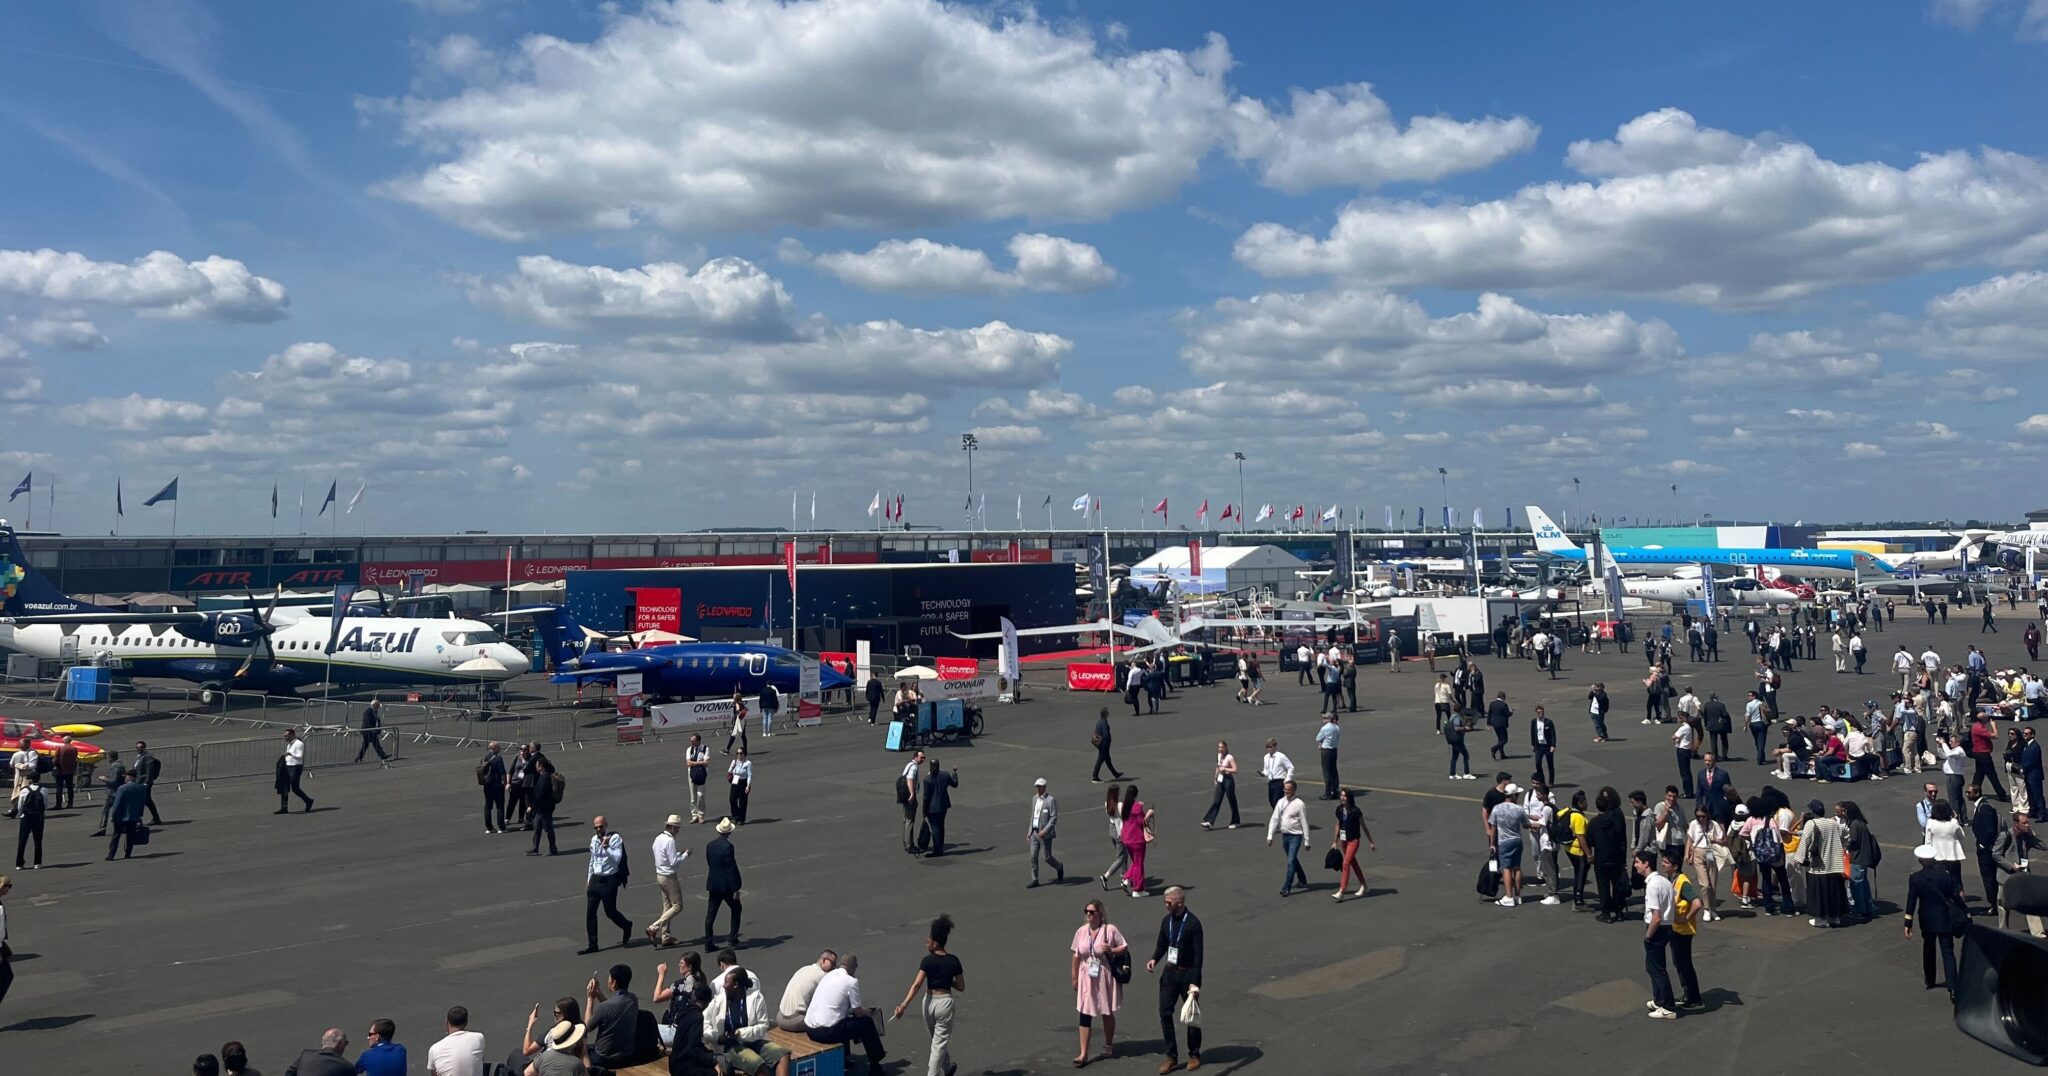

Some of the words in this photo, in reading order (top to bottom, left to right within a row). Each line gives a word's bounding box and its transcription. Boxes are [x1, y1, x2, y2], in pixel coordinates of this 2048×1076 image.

[186, 572, 253, 585] ATR
[283, 569, 345, 583] ATR
[24, 602, 78, 611] voeazul.com.br
[920, 599, 971, 610] TECHNOLOGY
[706, 606, 752, 617] LEONARDO
[945, 611, 969, 621] SAFER
[336, 626, 421, 653] Azul
[1078, 672, 1111, 681] LEONARDO
[944, 679, 985, 690] OYONNAIR
